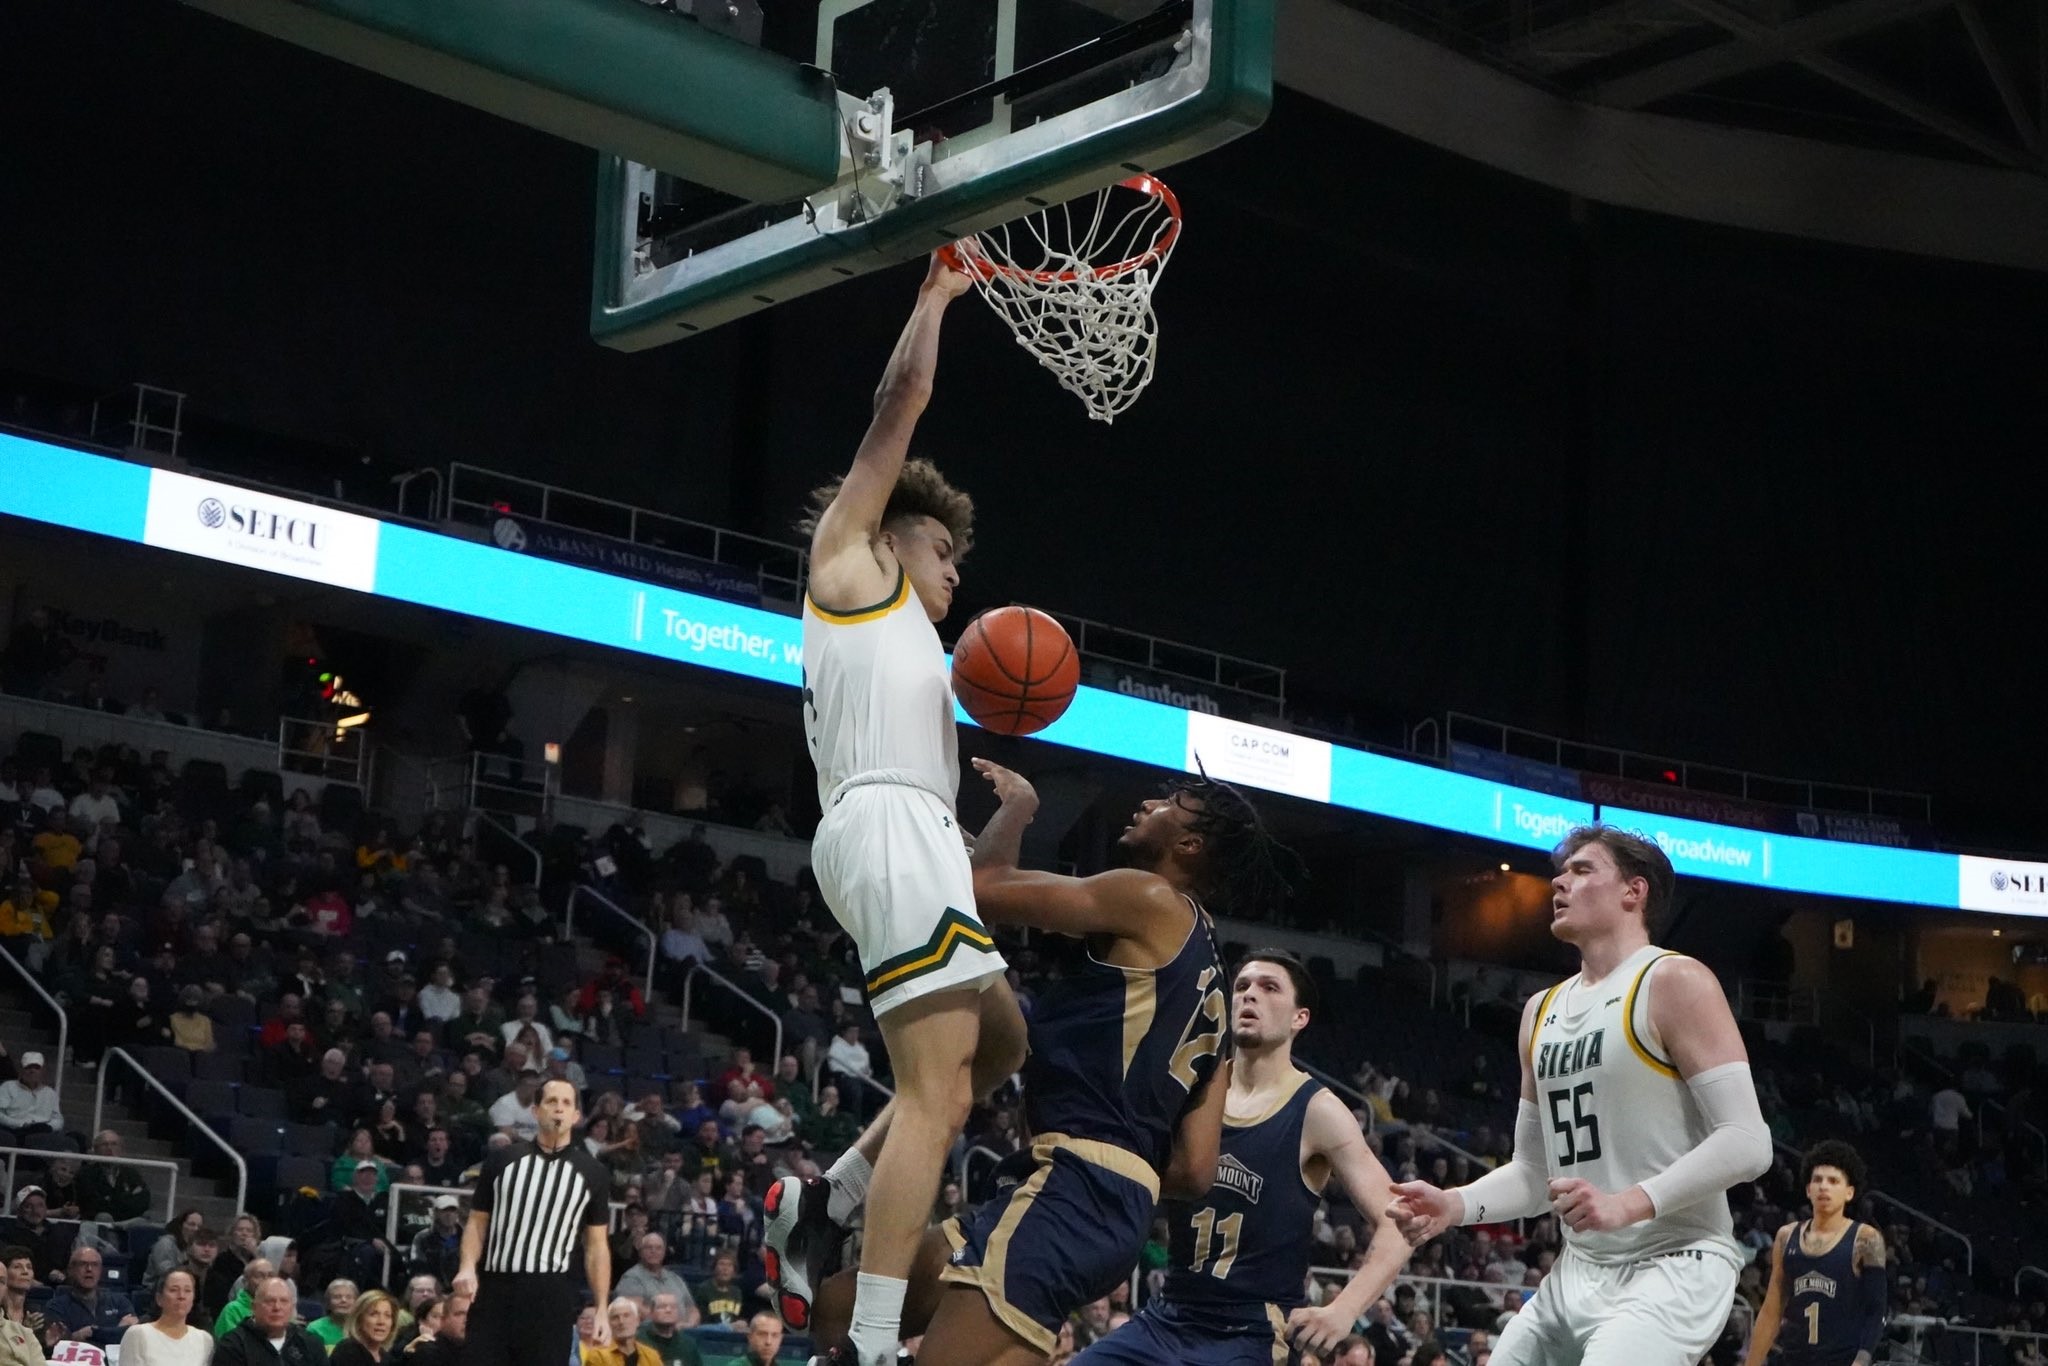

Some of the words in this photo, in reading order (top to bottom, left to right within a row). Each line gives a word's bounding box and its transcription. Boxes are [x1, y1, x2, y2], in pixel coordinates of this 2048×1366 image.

[228, 504, 327, 551] SEFCU
[611, 550, 651, 572] MED
[655, 561, 703, 583] Health
[662, 608, 776, 665] Together,
[1117, 674, 1220, 716] danforth
[1231, 735, 1259, 749] CAP
[1262, 741, 1290, 758] COM
[1537, 1028, 1606, 1081] SIENA
[1548, 1081, 1602, 1168] 55
[1216, 1165, 1260, 1197] MOUNT
[1188, 1206, 1244, 1280] 11
[1809, 1277, 1836, 1295] MOUNT
[1804, 1301, 1820, 1345] 1
